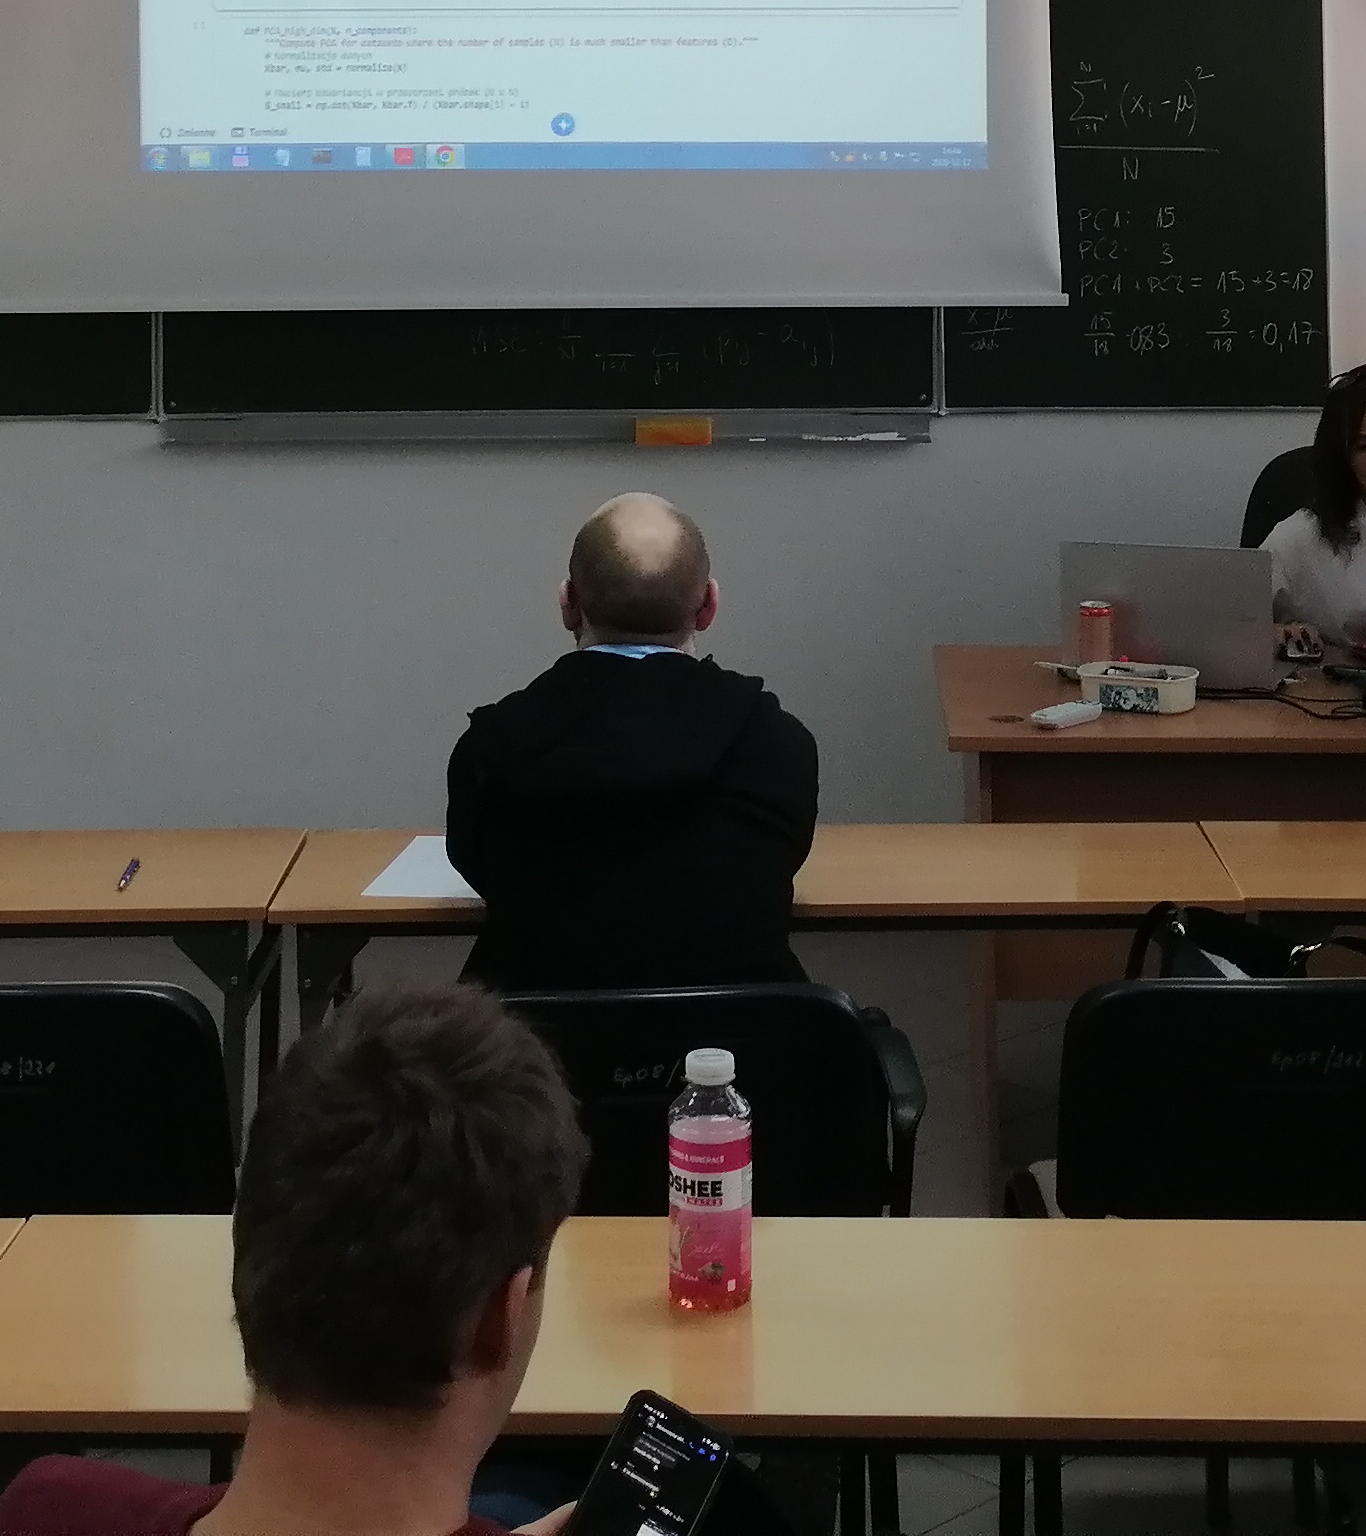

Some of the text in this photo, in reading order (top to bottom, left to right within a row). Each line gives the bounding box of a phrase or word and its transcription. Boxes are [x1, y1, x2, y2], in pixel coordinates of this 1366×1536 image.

[1123, 157, 1139, 180] N
[1159, 243, 1174, 265] 3
[1221, 308, 1231, 327] 3
